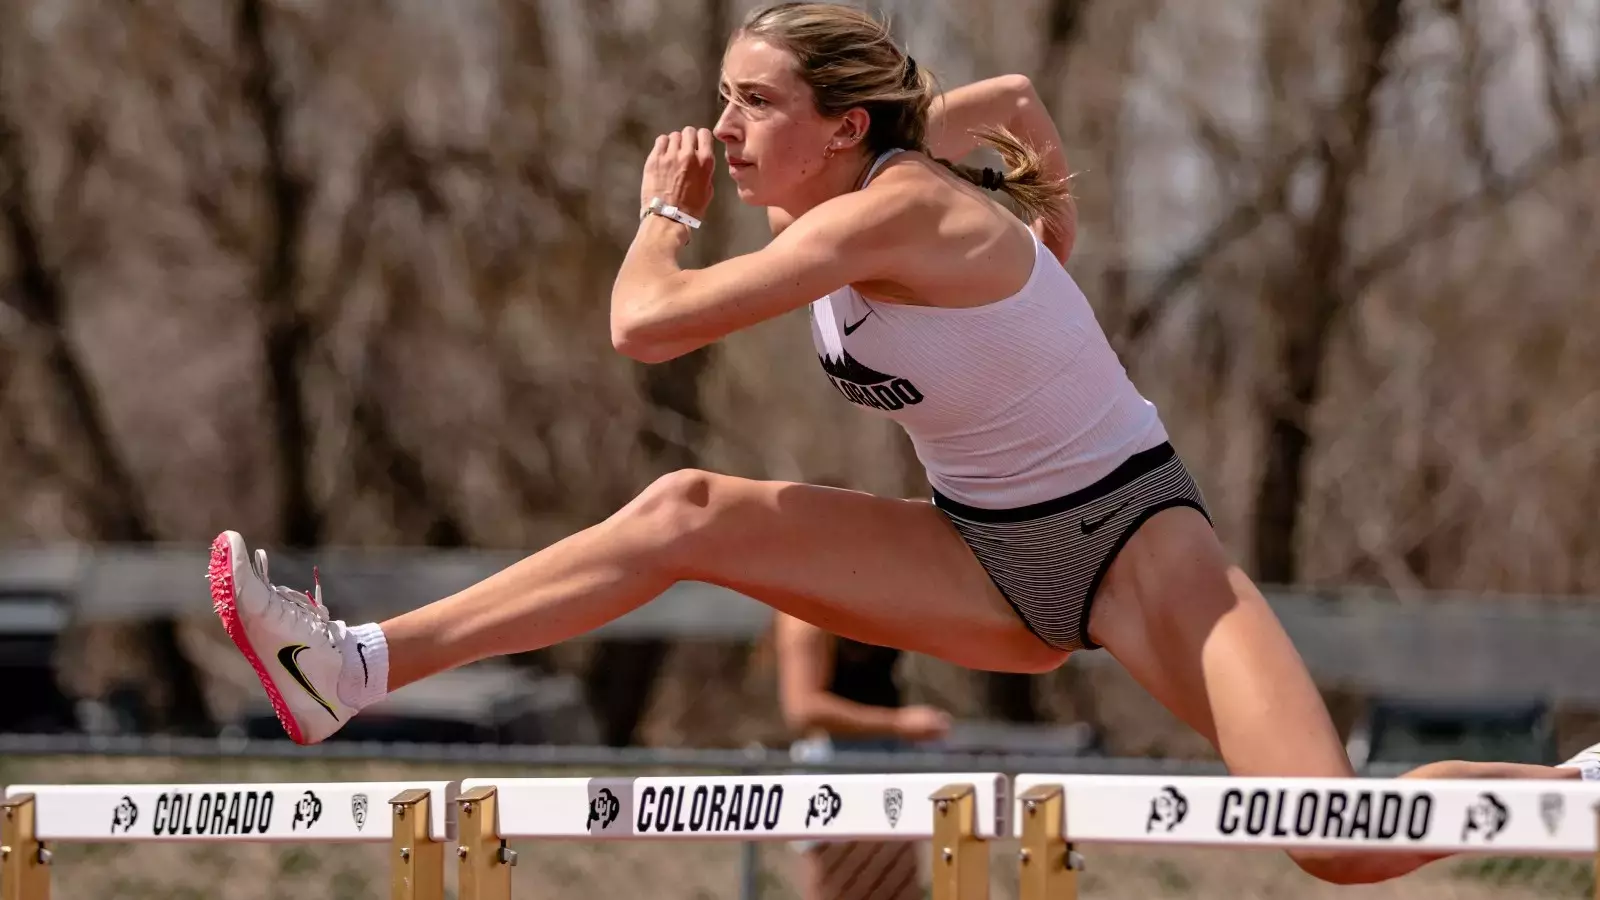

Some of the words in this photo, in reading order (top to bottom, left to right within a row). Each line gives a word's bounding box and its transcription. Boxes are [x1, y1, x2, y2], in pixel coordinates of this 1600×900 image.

[153, 791, 274, 836] COLORADO
[636, 784, 784, 832] COLORADO
[1218, 789, 1433, 841] COLORADO
